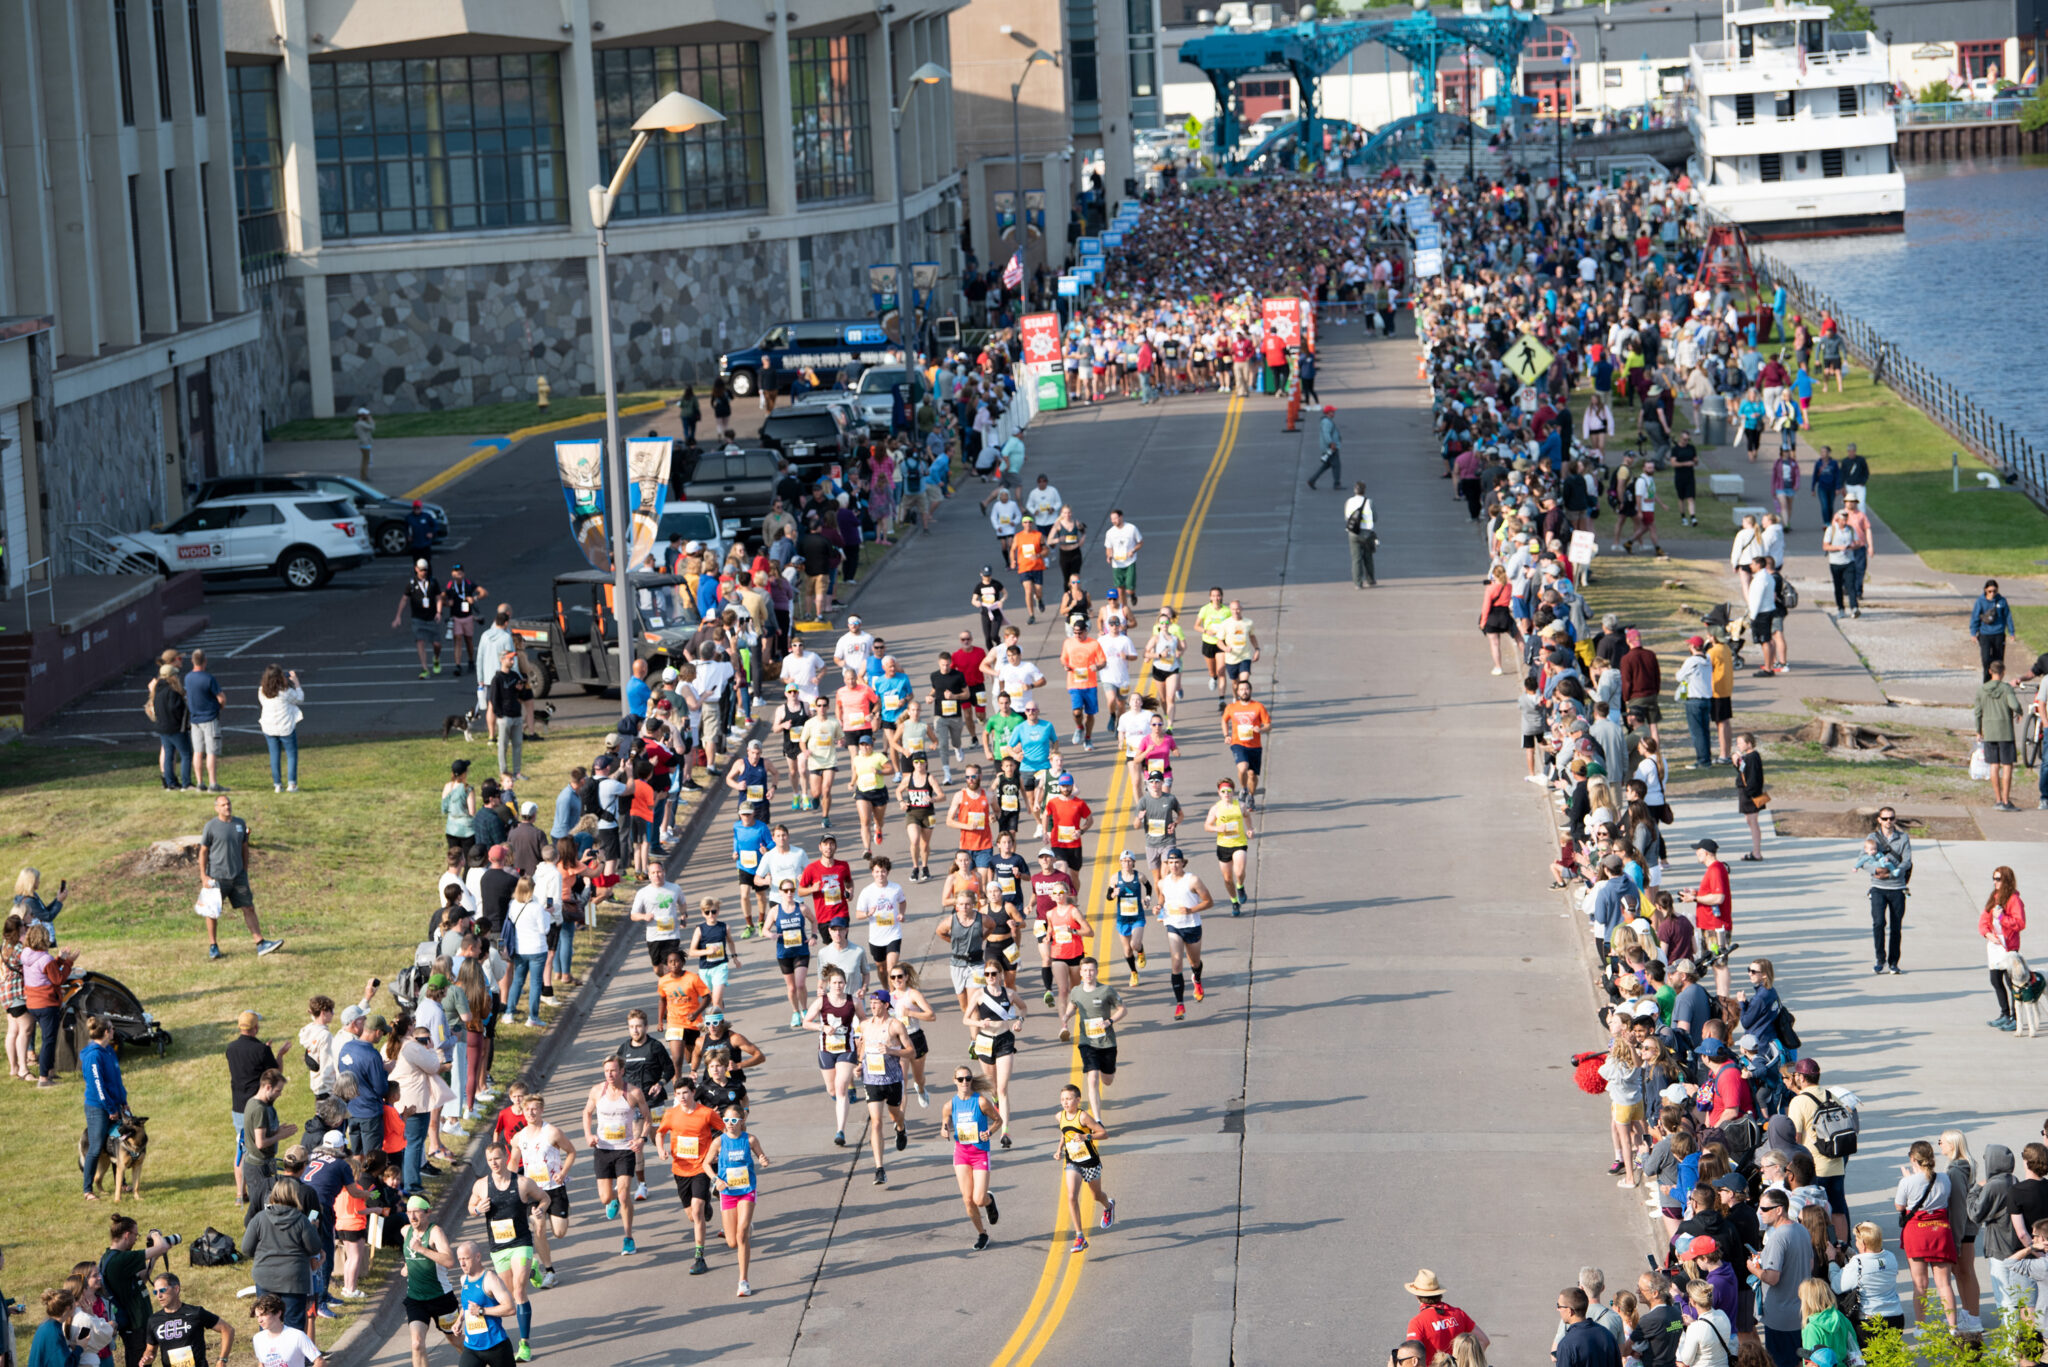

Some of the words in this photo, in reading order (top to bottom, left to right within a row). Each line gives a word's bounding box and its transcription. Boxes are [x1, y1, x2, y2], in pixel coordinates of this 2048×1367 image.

[1265, 300, 1296, 311] START
[1024, 316, 1054, 329] START
[166, 453, 174, 464] 3
[180, 548, 209, 557] WDIO
[304, 1160, 324, 1182] 7
